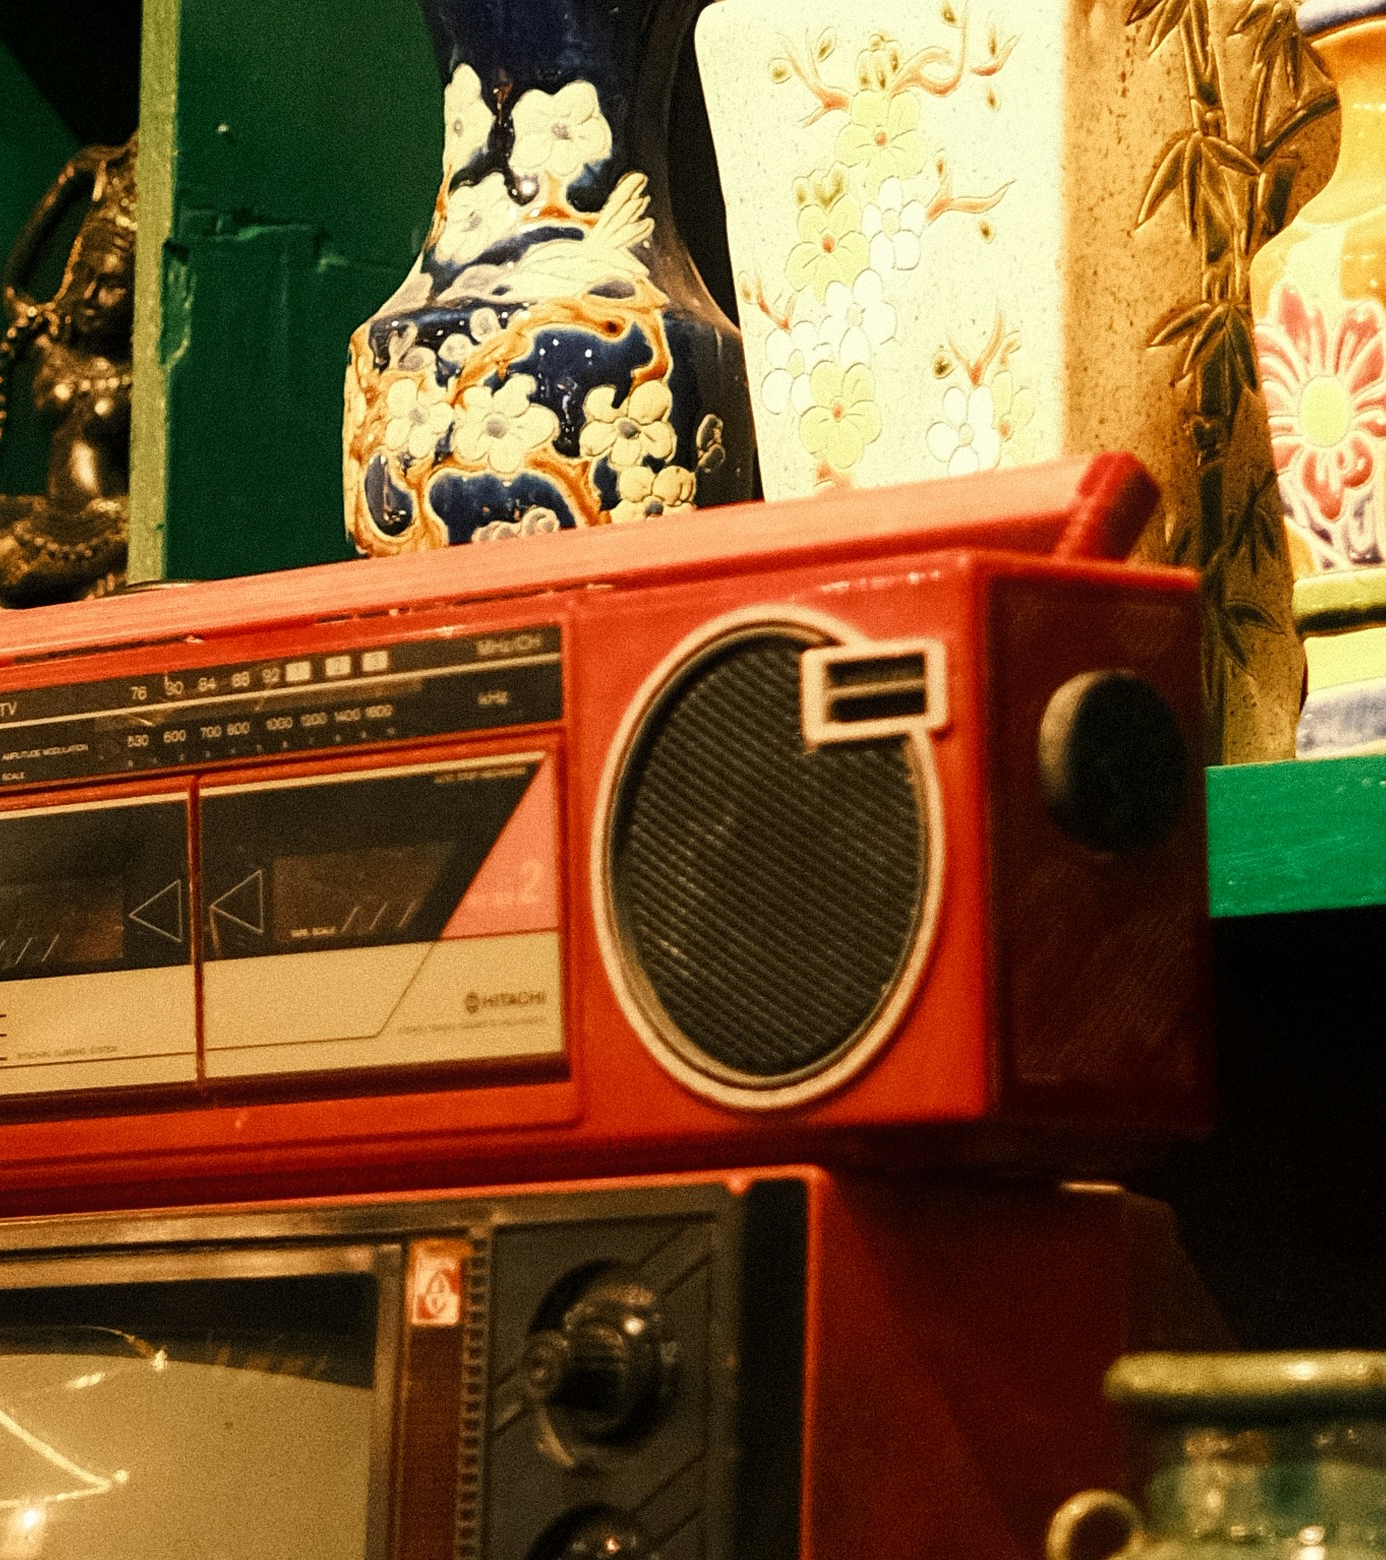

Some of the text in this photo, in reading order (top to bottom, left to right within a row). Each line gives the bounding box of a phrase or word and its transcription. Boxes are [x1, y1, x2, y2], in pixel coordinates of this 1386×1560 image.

[130, 686, 148, 701] 76
[197, 677, 217, 692] 84
[262, 668, 281, 684] 92
[163, 730, 187, 744] 600
[200, 725, 222, 739] 700
[266, 717, 294, 731] 1000
[481, 990, 548, 1008] HITACHI
